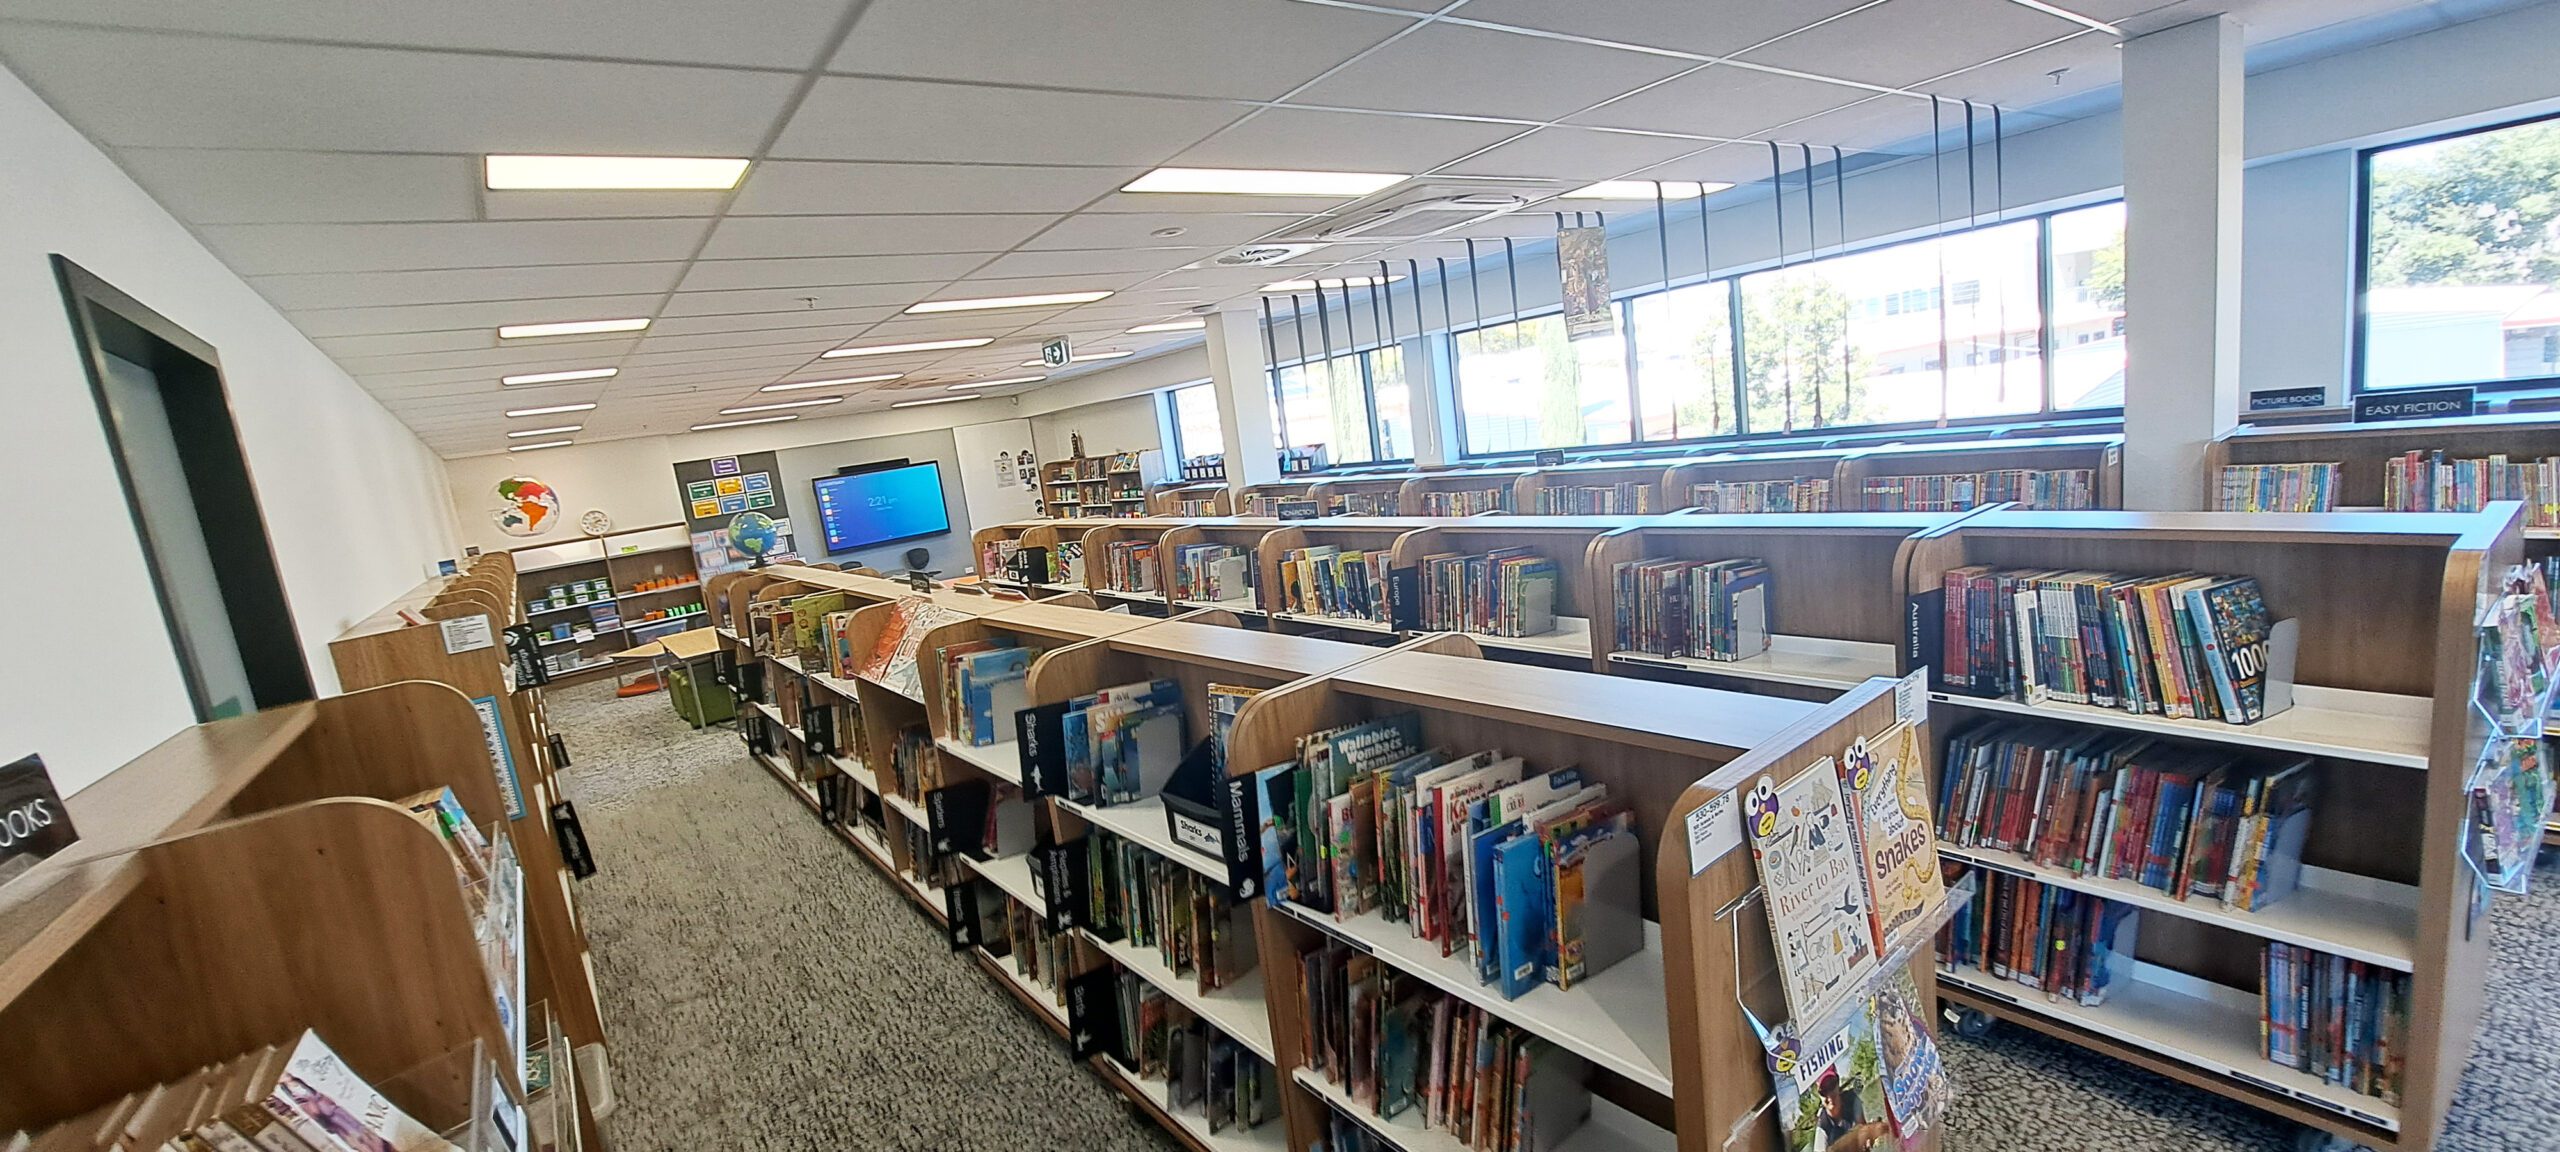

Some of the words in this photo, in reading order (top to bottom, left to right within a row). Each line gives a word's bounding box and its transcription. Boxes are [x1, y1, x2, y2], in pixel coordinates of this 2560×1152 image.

[2252, 396, 2287, 406] PICTURE
[2289, 394, 2323, 404] BOOKS
[2365, 405, 2400, 416] EASY
[2404, 401, 2461, 414] FICTION
[1911, 602, 1920, 658] Australia
[1025, 713, 1039, 757] Sharks
[1870, 763, 1898, 816] Everything
[1180, 819, 1203, 837] Sharks
[1229, 780, 1250, 863] Mammals
[1779, 882, 1814, 917] River
[1815, 873, 1828, 890] to
[1829, 857, 1849, 879] Bay
[1800, 1034, 1844, 1082] FISHING
